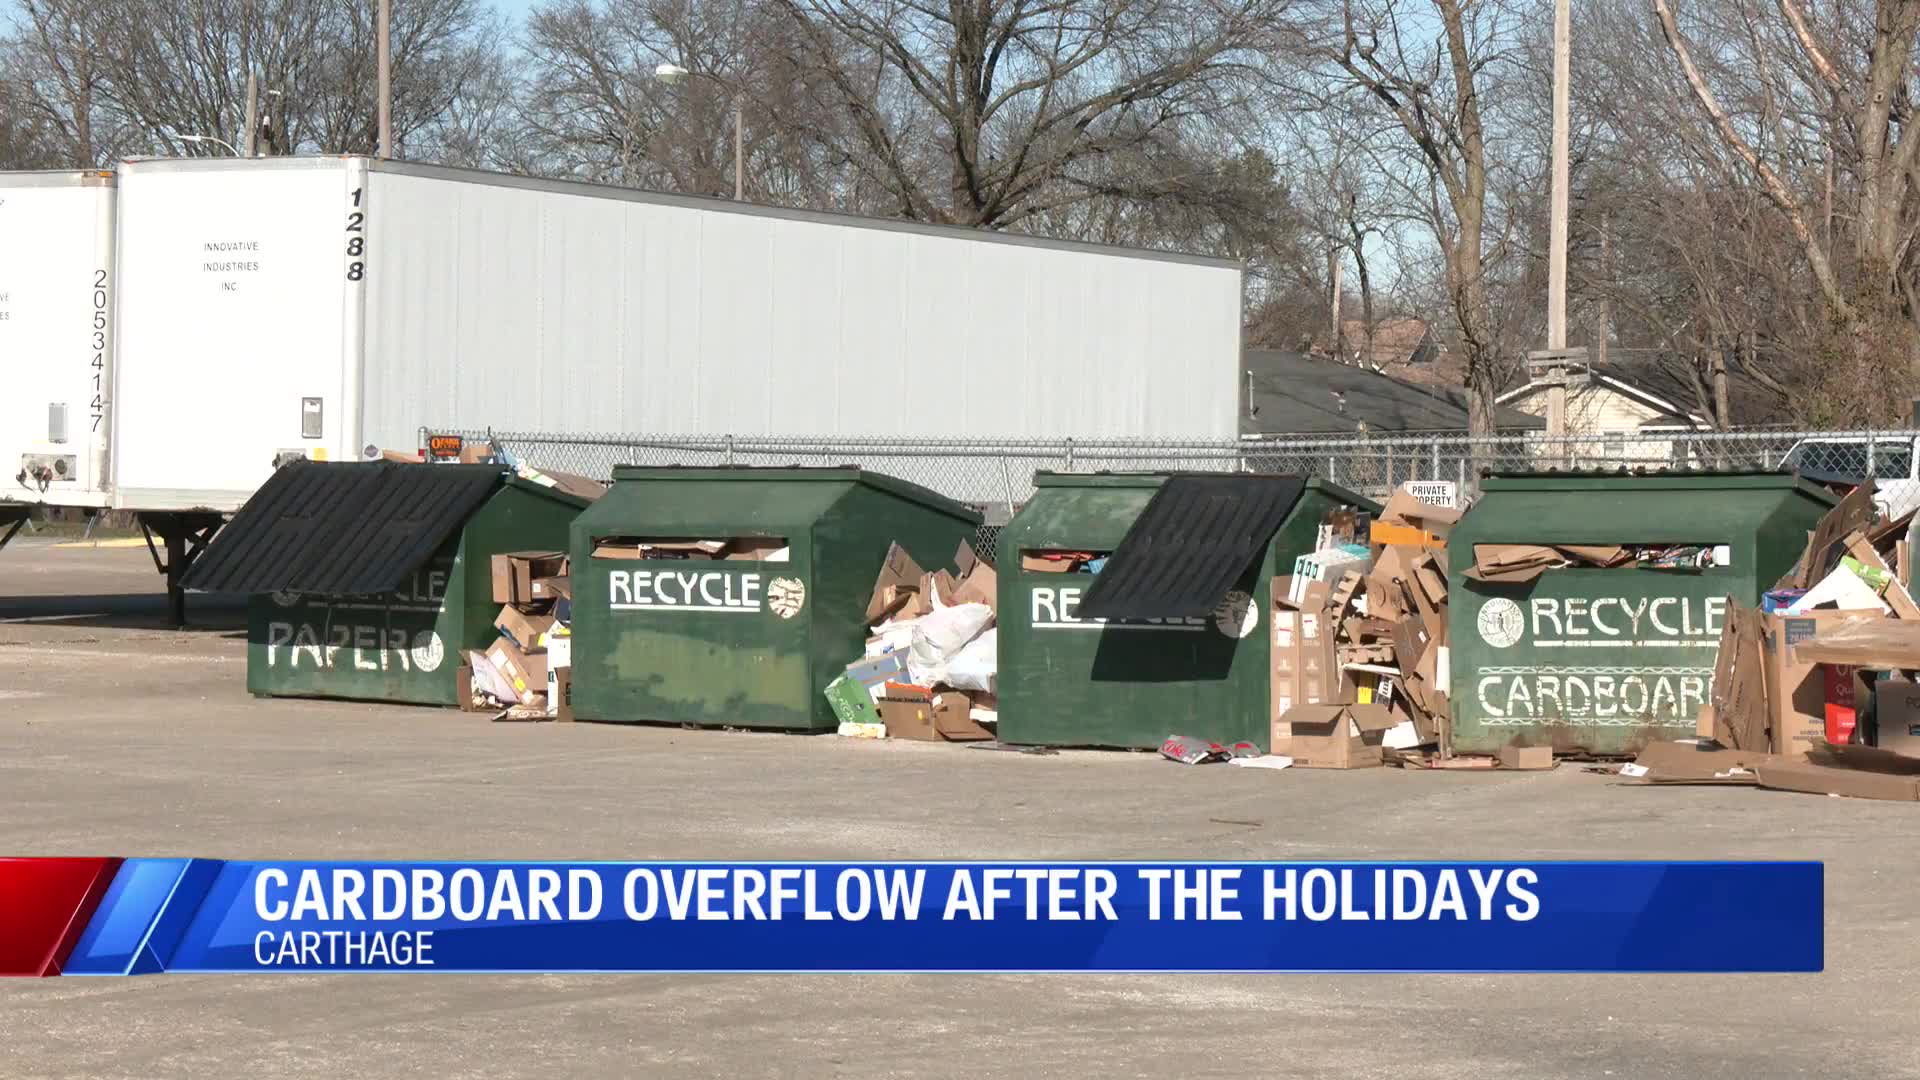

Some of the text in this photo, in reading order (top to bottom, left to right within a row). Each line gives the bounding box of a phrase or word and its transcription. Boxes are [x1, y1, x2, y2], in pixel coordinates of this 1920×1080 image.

[346, 187, 364, 281] 1288
[204, 241, 259, 251] INNOVATIVE
[203, 262, 259, 272] INDUSTRIES
[90, 269, 107, 433] 20534147
[1412, 485, 1447, 495] PRIVATE
[1418, 495, 1451, 505] OPERTY
[610, 571, 760, 606] RECYCLE
[1531, 597, 1726, 635] RECYCLE
